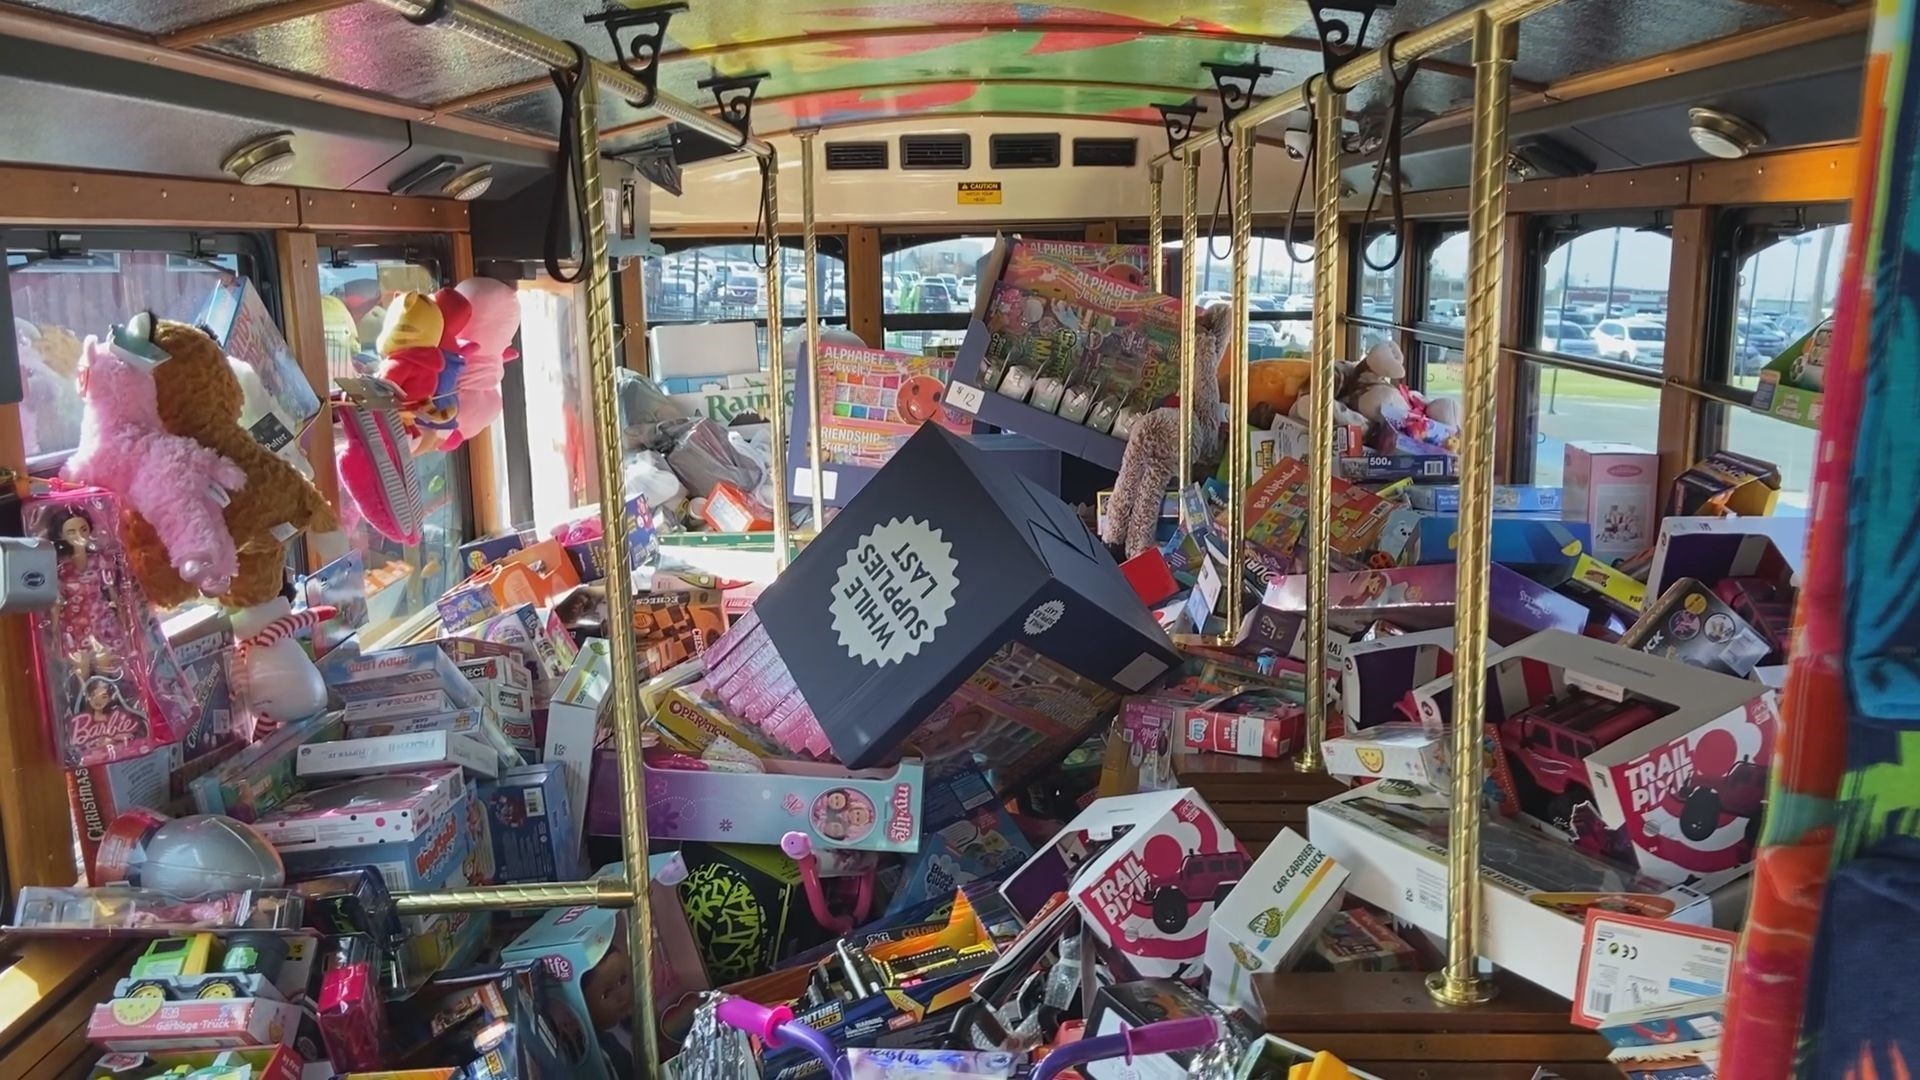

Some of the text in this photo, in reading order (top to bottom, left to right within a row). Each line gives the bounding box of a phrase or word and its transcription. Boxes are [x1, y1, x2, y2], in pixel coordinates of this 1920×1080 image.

[1029, 242, 1085, 257] ALPHABET
[1075, 271, 1139, 300] ALPHABET
[824, 346, 885, 366] ALPHABET
[821, 426, 881, 445] RIENDSHIP
[890, 541, 938, 600] LAST
[858, 543, 929, 641] SUPPLIES
[843, 576, 896, 651] WHILE
[71, 710, 139, 746] Barbie
[1624, 743, 1692, 791] TRAIL
[75, 767, 105, 842] CHRISTMAS
[1089, 855, 1145, 909] TRAIL
[1271, 842, 1317, 894] CAR CARRIER
[1300, 849, 1327, 879] TRUCK
[155, 1016, 230, 1032] Garbage Truck
